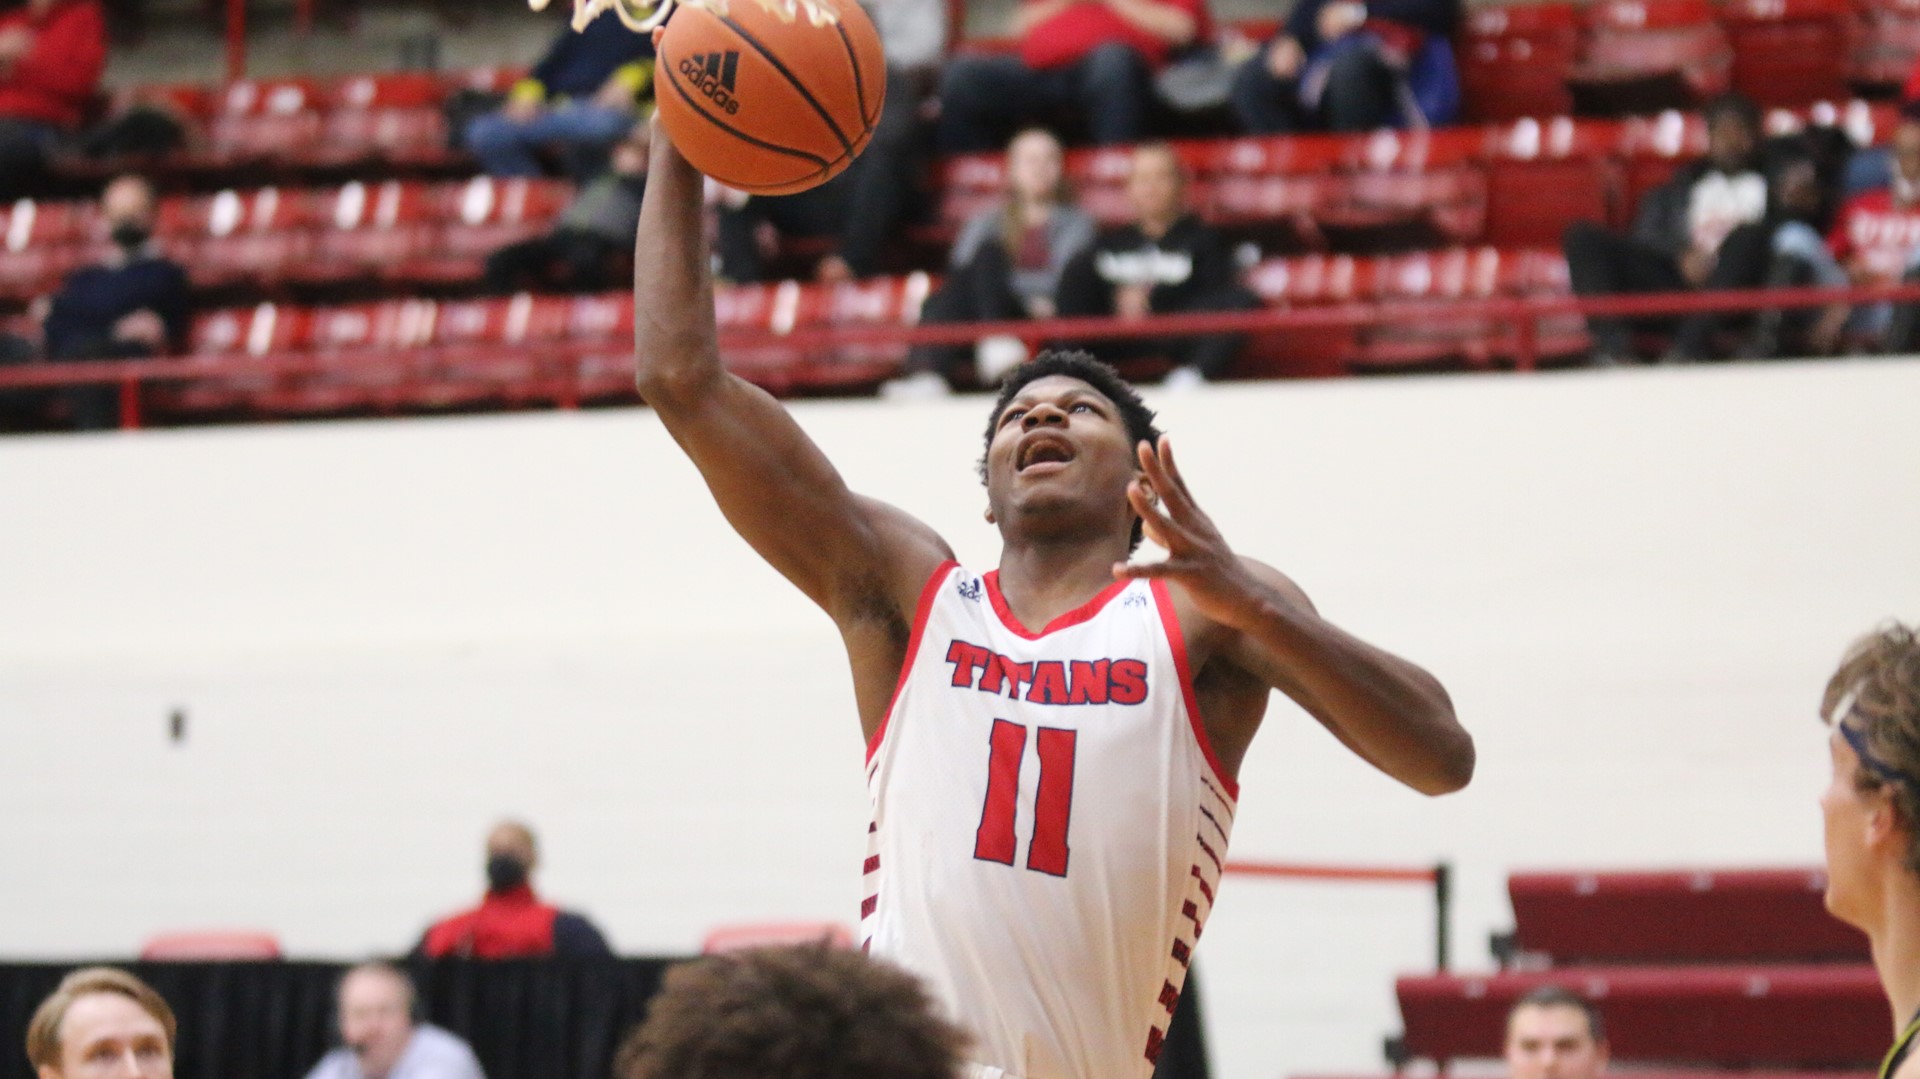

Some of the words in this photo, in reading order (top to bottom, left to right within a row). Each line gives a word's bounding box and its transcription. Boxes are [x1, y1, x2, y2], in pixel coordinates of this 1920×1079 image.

[679, 59, 739, 115] adidas
[945, 639, 1148, 705] TITANS
[973, 717, 1077, 878] 11
